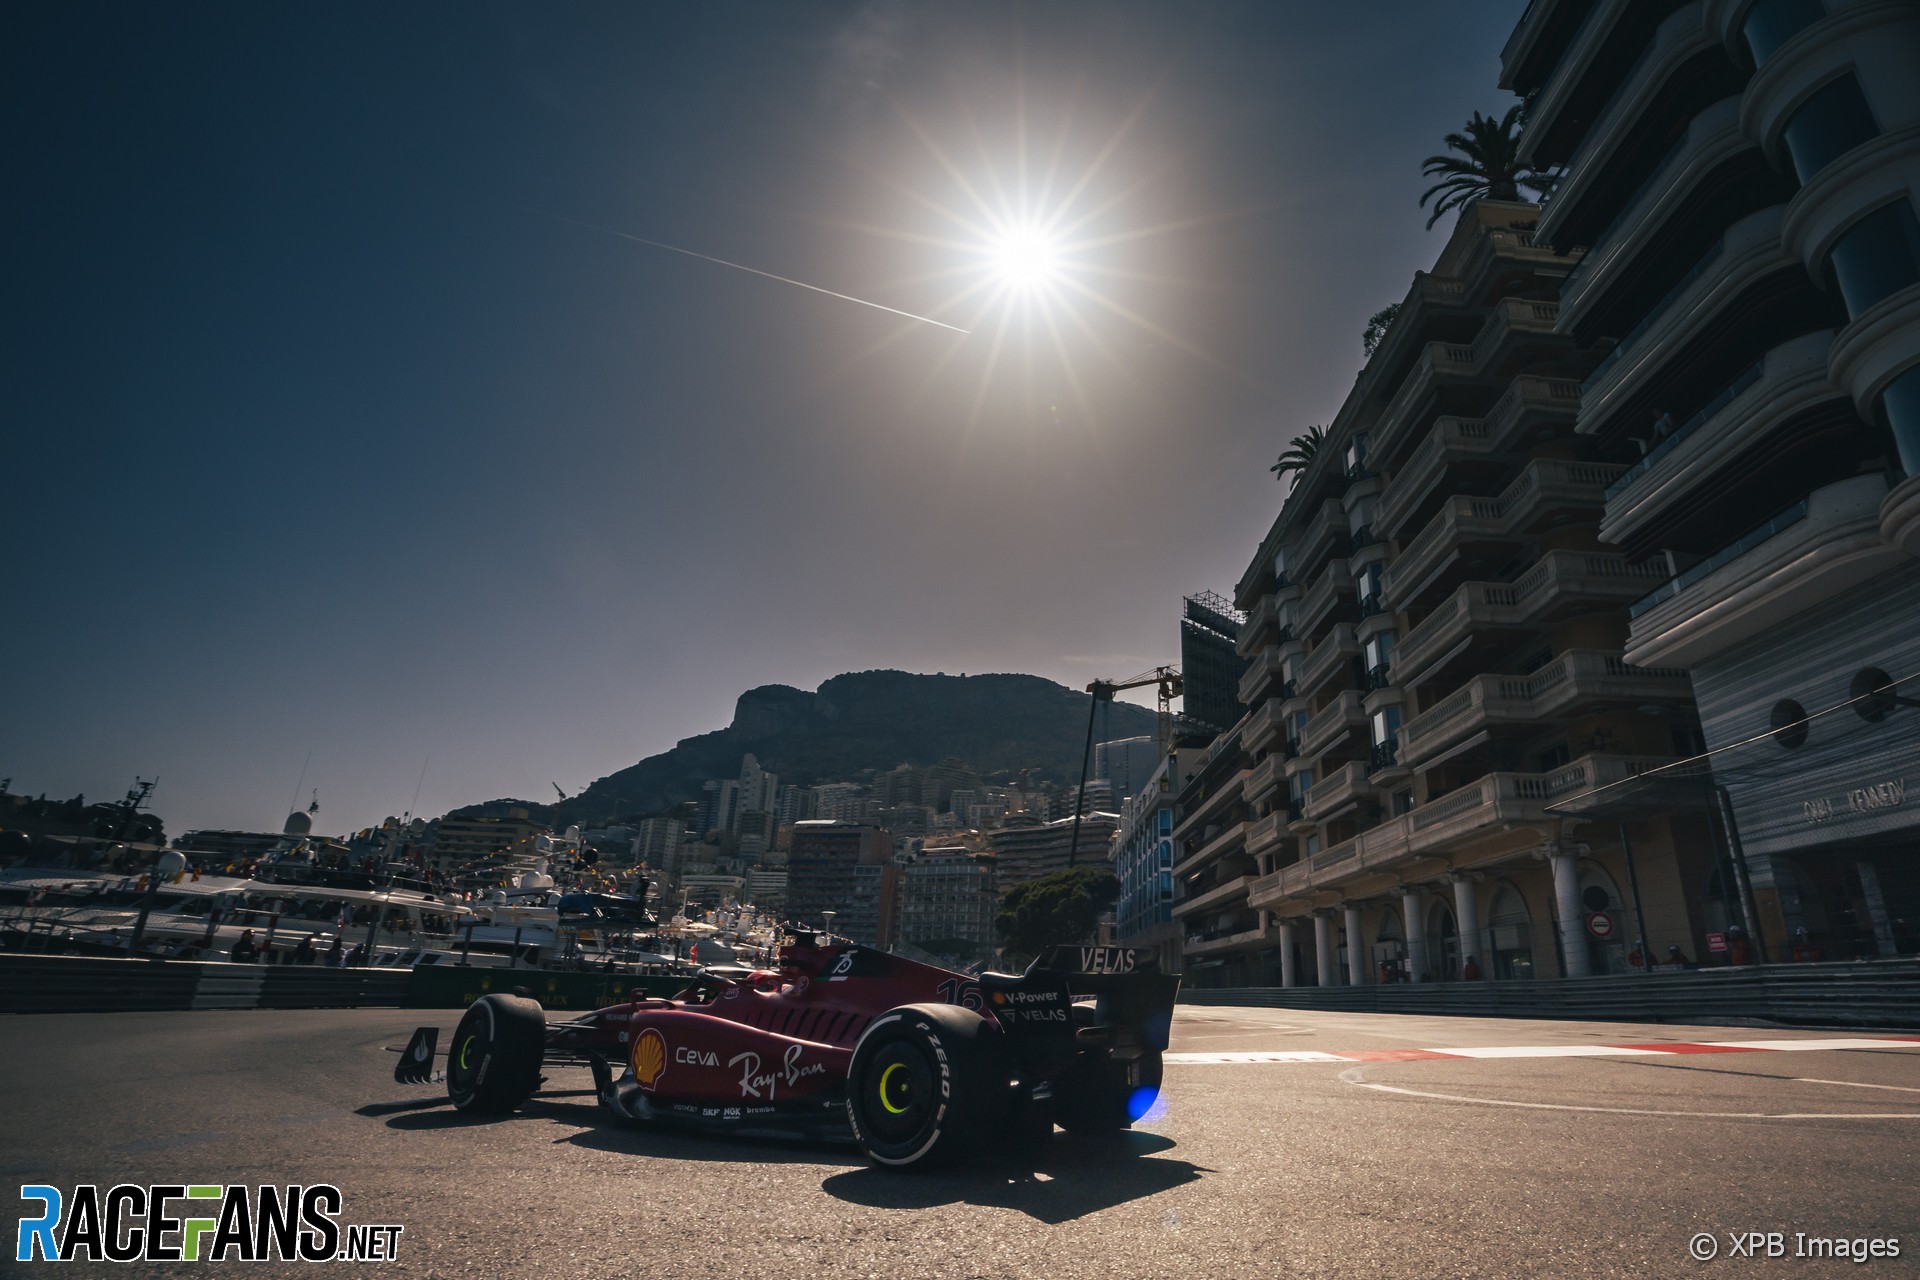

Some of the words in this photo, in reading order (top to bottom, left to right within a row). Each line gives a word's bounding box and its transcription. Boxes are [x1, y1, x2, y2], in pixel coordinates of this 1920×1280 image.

[1847, 778, 1906, 813] KENNEDY
[1081, 947, 1136, 973] VELAS
[936, 977, 984, 1013] 16
[1005, 991, 1059, 1005] V-Power
[1020, 1009, 1067, 1023] VELAS
[927, 1034, 951, 1099] ZERO
[702, 1107, 720, 1117] SKF
[723, 1107, 741, 1116] NGK
[746, 1106, 776, 1114] brembo
